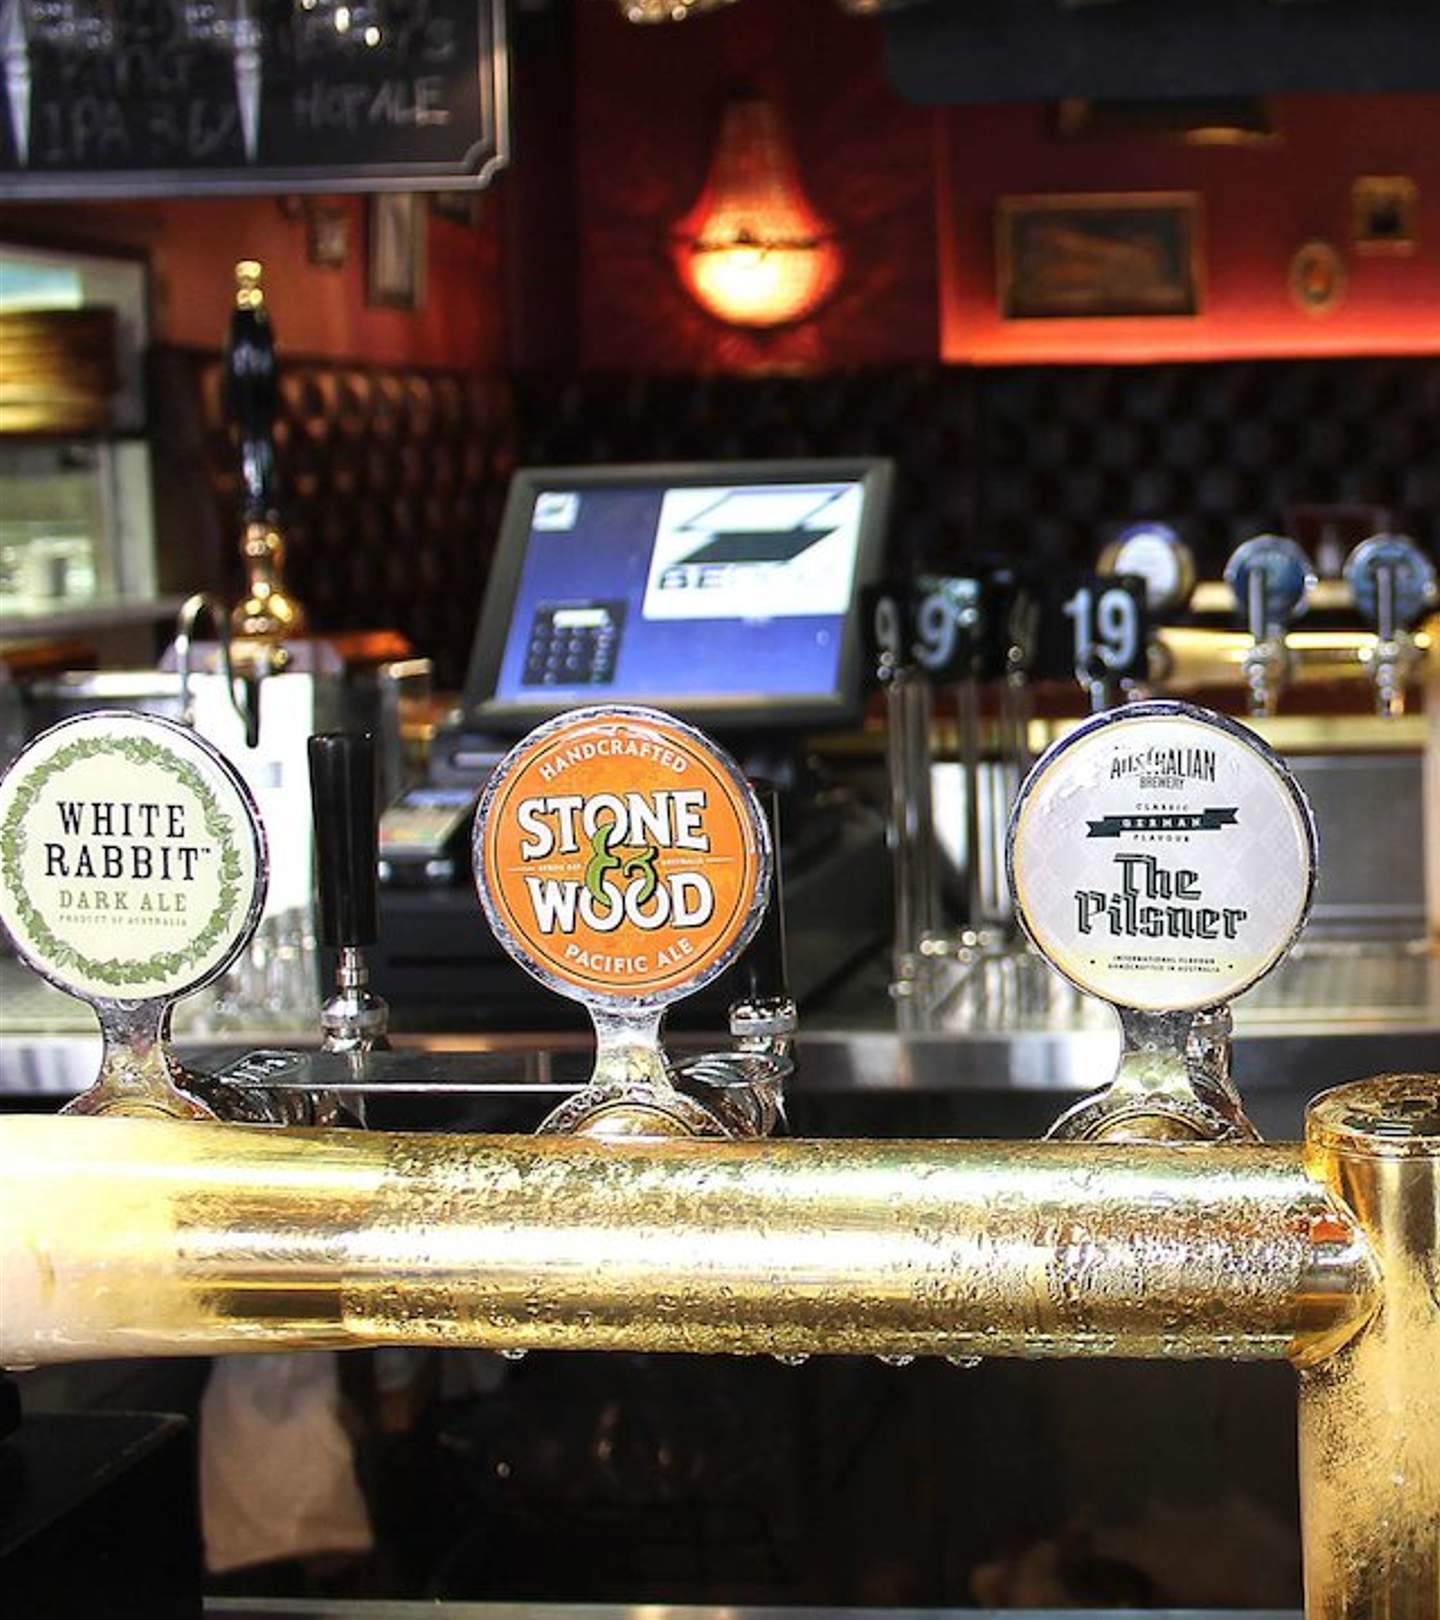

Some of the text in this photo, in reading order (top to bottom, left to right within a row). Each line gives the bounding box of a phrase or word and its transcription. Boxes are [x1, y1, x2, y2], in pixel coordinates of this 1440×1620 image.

[1062, 588, 1139, 670] 19
[539, 738, 689, 781] HANDCRAFTED
[1139, 776, 1185, 790] BREWERY
[56, 802, 186, 838] WHITE
[517, 790, 711, 862] STONE
[1122, 818, 1202, 829] GERMAN
[1133, 834, 1190, 843] FLAVOUR
[1112, 853, 1203, 902] The
[59, 890, 187, 912] DARK ALE
[524, 873, 713, 935] WOOD
[1074, 890, 1248, 940] Pilsner
[564, 937, 695, 974] PACIFIC ALE
